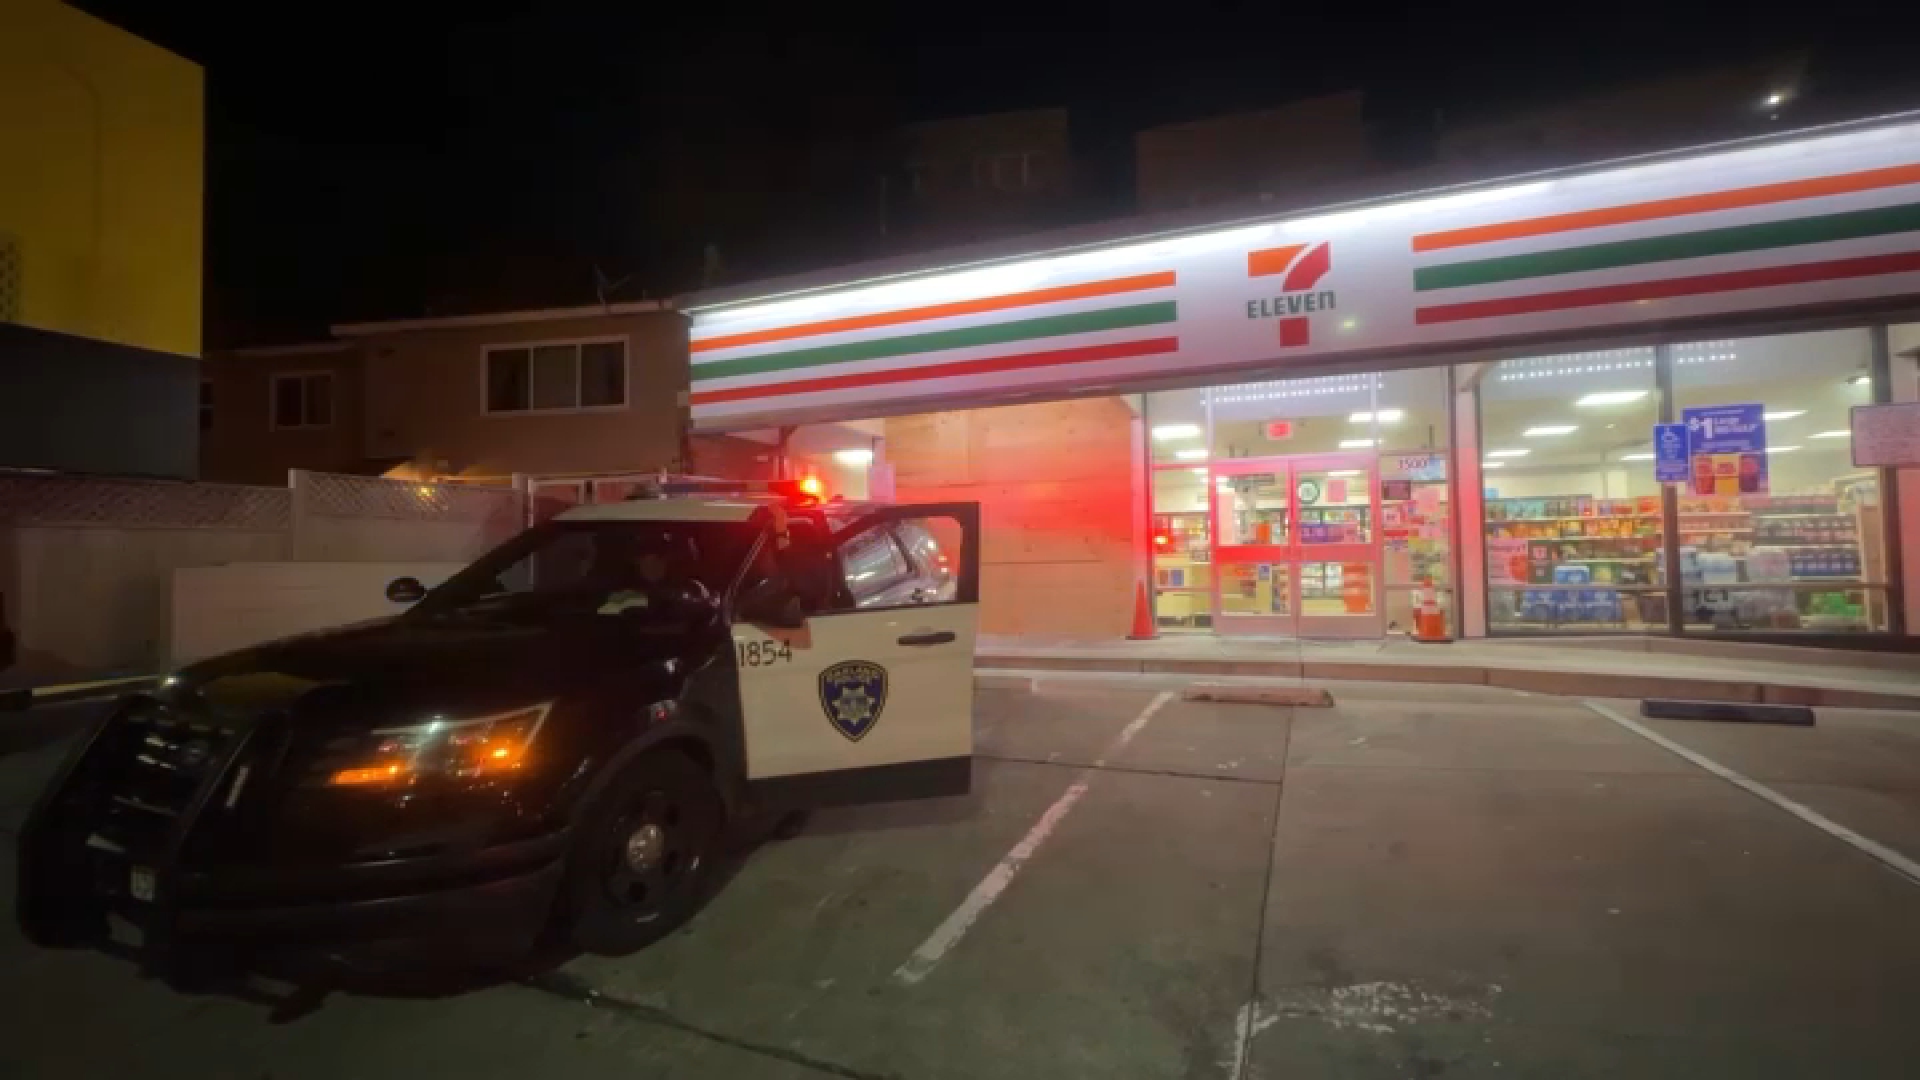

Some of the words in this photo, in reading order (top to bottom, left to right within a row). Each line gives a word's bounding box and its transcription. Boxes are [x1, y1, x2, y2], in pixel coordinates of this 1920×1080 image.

[1248, 241, 1331, 347] 7
[1689, 416, 1713, 439] $1
[738, 640, 793, 667] 1854
